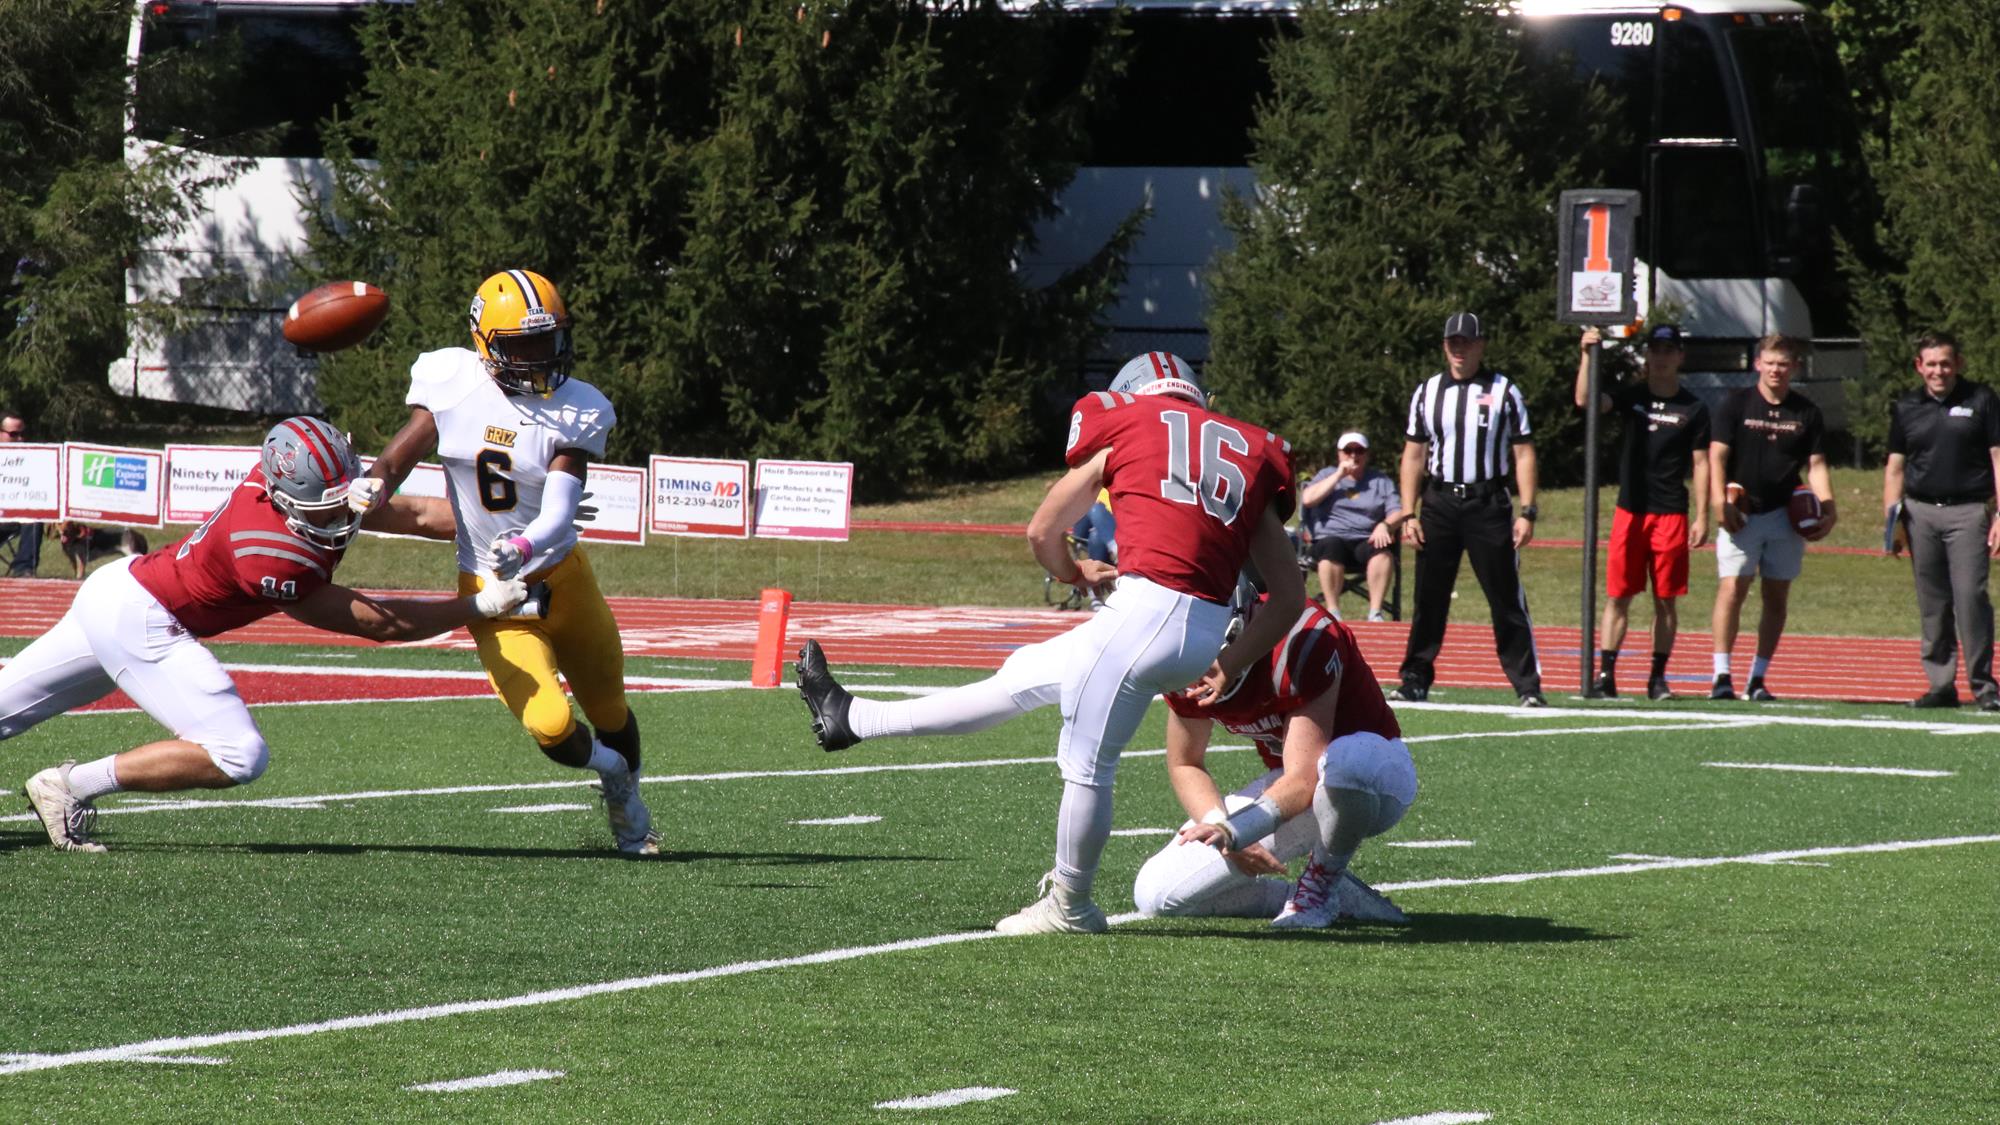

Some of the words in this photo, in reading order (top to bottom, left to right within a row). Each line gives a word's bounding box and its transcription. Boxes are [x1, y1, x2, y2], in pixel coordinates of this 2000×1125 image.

[1610, 21, 1654, 46] 9280
[1583, 203, 1612, 272] 1
[528, 307, 544, 315] TEAM
[1167, 381, 1200, 398] ENGINEERS
[1478, 413, 1488, 427] L
[484, 425, 518, 448] GRIZ
[1, 456, 25, 467] Jeff
[1160, 409, 1249, 526] 16
[172, 468, 219, 481] Ninety
[476, 448, 519, 514] 6
[658, 478, 712, 492] TIMING
[713, 481, 741, 497] MD
[657, 495, 740, 509] 812-239-4207
[261, 575, 299, 600] 11
[1324, 649, 1343, 679] 7
